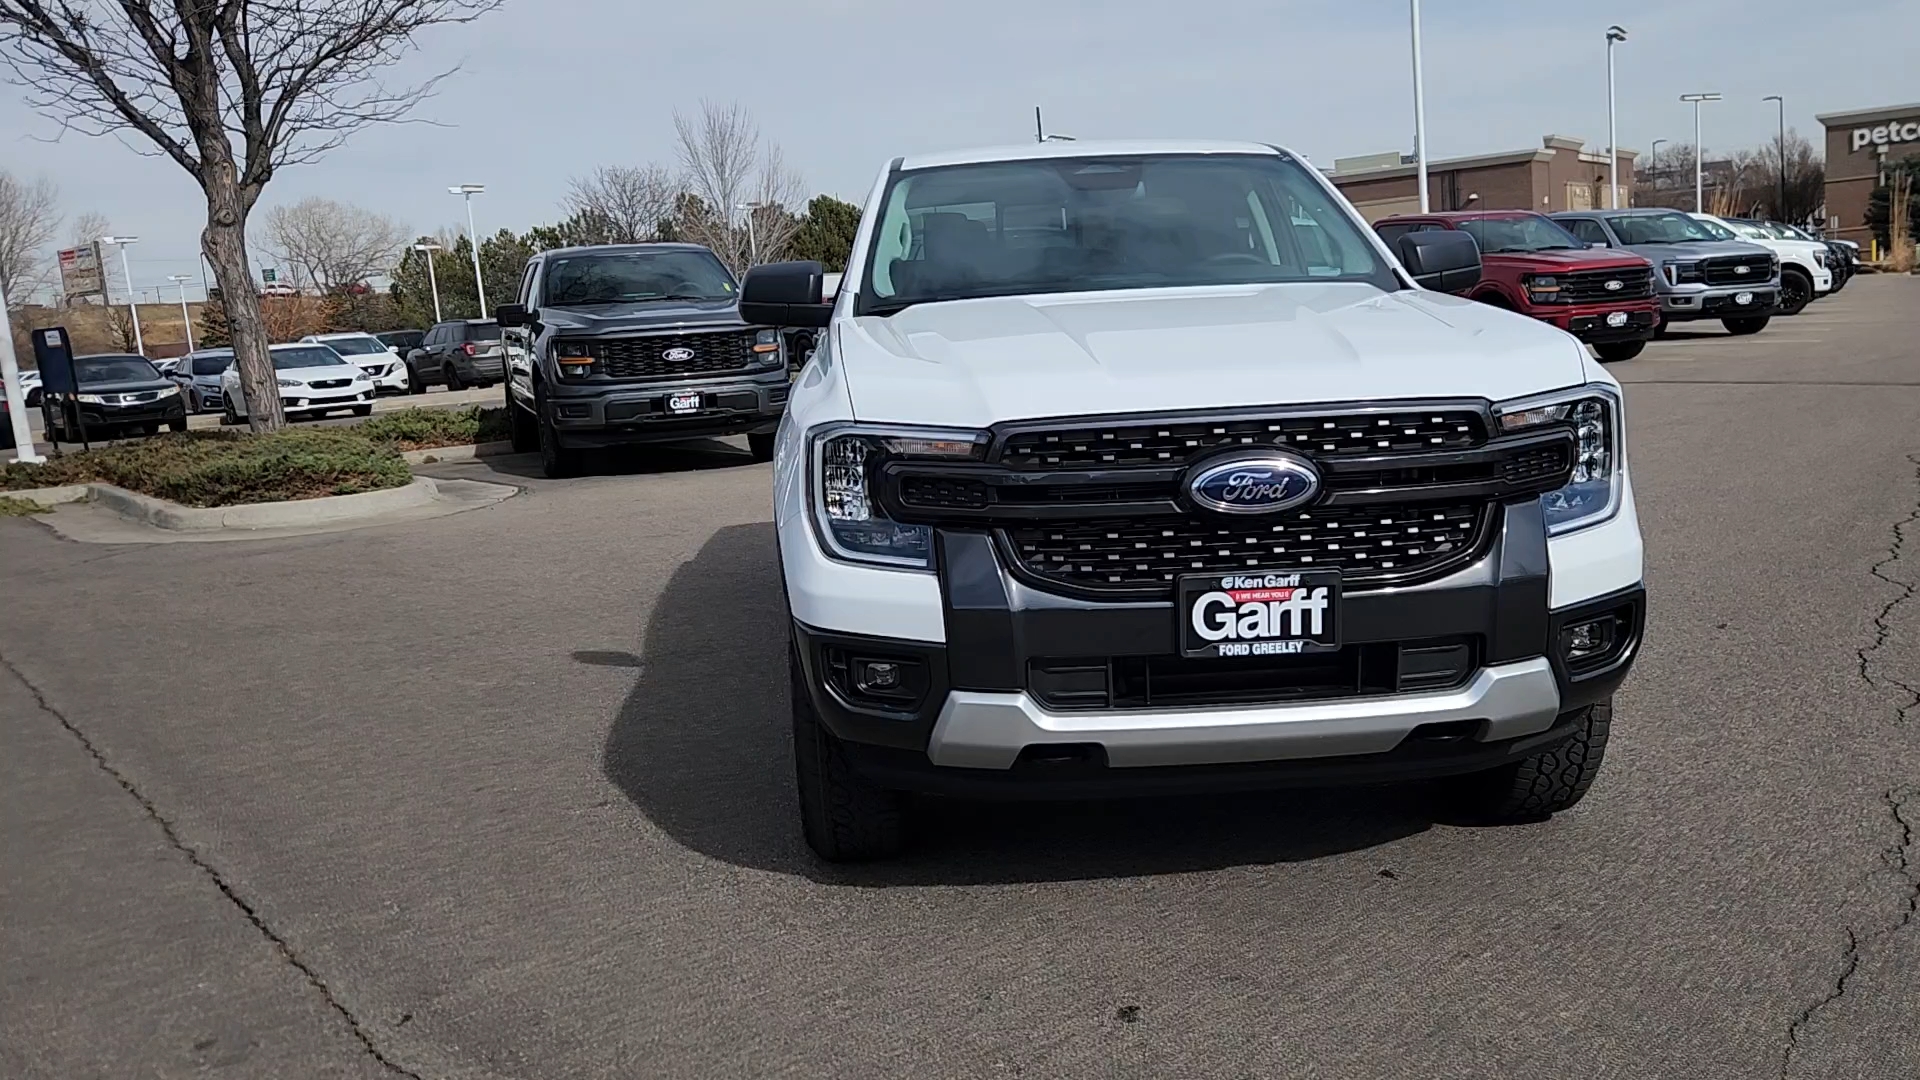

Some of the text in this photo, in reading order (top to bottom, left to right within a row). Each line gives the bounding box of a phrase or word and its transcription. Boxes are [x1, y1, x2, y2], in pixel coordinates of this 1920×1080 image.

[1852, 121, 1920, 151] petc
[669, 395, 700, 409] Garff
[1222, 472, 1289, 500] Ford
[1234, 576, 1262, 589] Ken
[1263, 575, 1300, 588] Garff
[1192, 587, 1328, 641] Garff
[1219, 641, 1303, 657] FORD GREELEY
